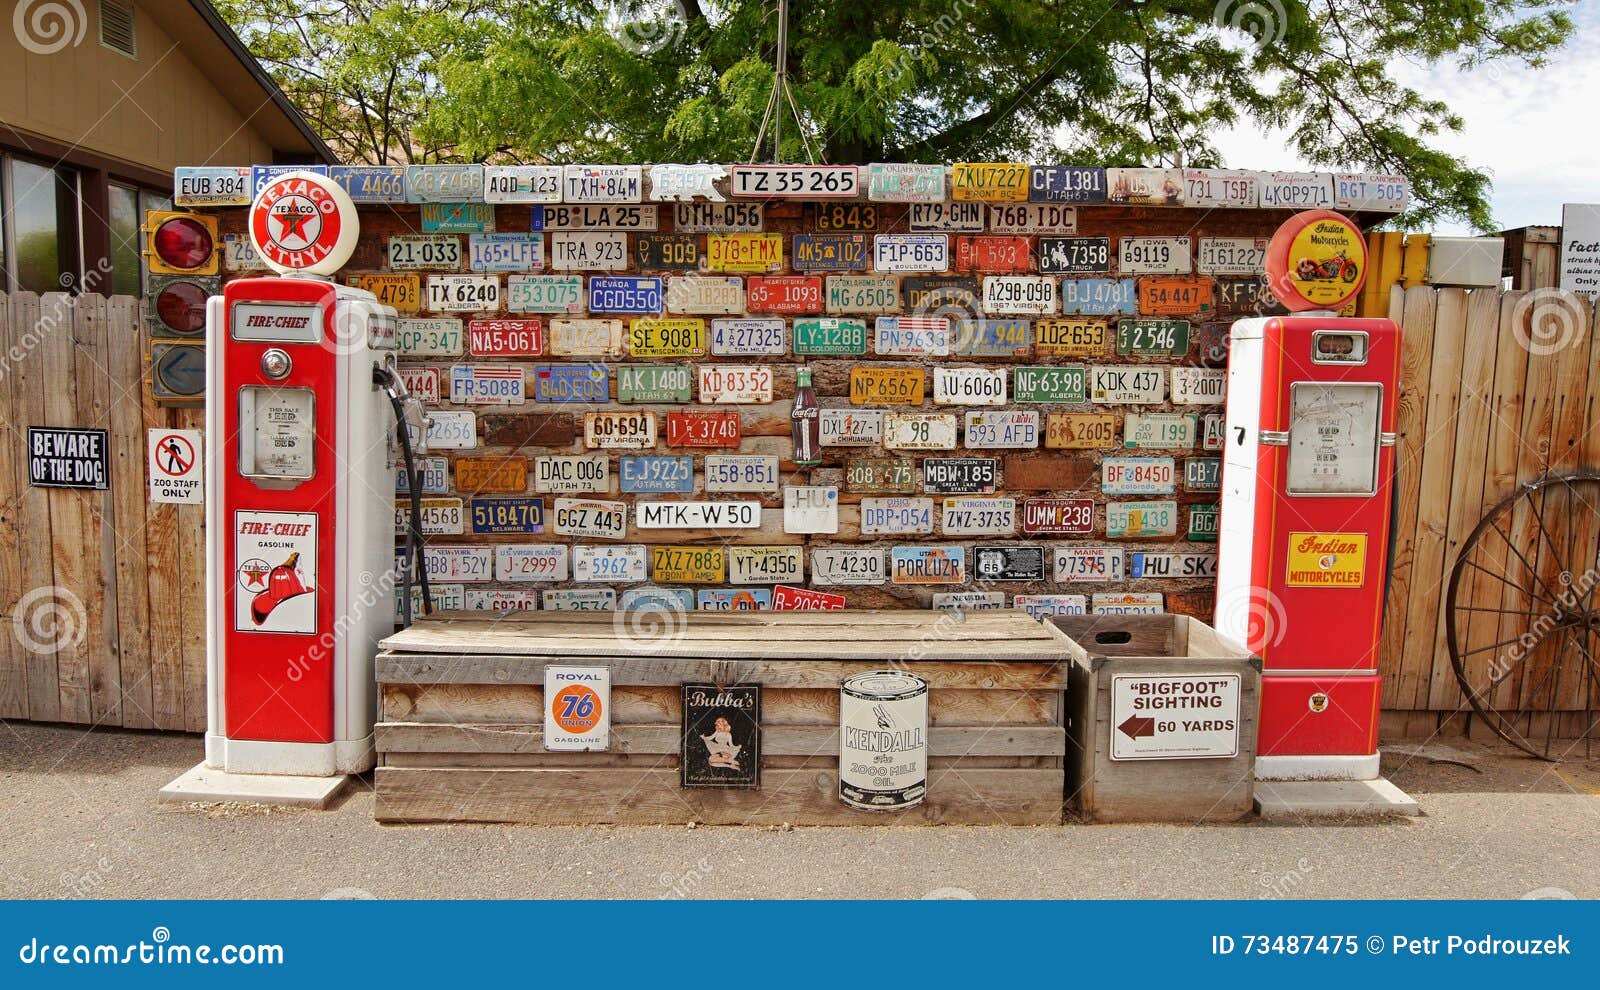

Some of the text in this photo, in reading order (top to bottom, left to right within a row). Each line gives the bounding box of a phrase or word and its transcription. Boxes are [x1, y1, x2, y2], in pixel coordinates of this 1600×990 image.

[182, 178, 210, 194] EUB
[216, 178, 244, 194] 384
[362, 176, 400, 194] 4466
[490, 177, 557, 192] AQD 123
[736, 172, 768, 191] TZ
[776, 173, 803, 191] 35
[810, 172, 854, 191] 265
[958, 169, 1025, 187] ZKU 7227
[1034, 170, 1099, 191] CF 1381
[570, 178, 637, 198] TXH 84M
[1189, 180, 1247, 200] 731 TSB
[1340, 182, 1403, 200] RGT 505
[257, 180, 334, 215] TEXACO
[544, 208, 640, 226] PB LA 25
[833, 207, 875, 228] 843
[914, 204, 979, 222] R79 GHN
[1315, 223, 1344, 234] Indian
[750, 240, 777, 260] FMX
[1310, 235, 1349, 248] Motorcycles
[263, 242, 331, 267] ETHYL
[475, 244, 539, 263] 165 LFE
[557, 242, 622, 260] TRA 923
[663, 244, 696, 264] 909
[1071, 246, 1106, 264] 7358
[1134, 247, 1169, 262] 9119
[380, 285, 406, 304] 479
[431, 285, 496, 302] TX 6240
[784, 287, 818, 302] 1093
[247, 316, 310, 328] FIRE-CHIEF
[634, 329, 653, 348] SE
[660, 329, 699, 348] 9081
[737, 329, 781, 346] 27325
[622, 372, 645, 390] AK
[856, 378, 918, 396] NP 6567
[1097, 372, 1158, 391] KDK 437
[969, 425, 1035, 442] 593 AFB
[1078, 423, 1112, 440] 2605
[33, 433, 99, 458] BEWARE
[33, 458, 103, 482] OF THE DOG
[541, 461, 603, 481] DAC 006
[624, 461, 688, 481] EJ 9225
[963, 466, 993, 482] 185
[154, 479, 199, 488] ZOO STAFF
[162, 488, 191, 498] ONLY
[476, 506, 540, 525] 518470
[558, 509, 622, 531] GGZ 443
[728, 505, 752, 524] 50
[1062, 507, 1091, 525] 238
[240, 522, 311, 536] FIRE-CHIEF
[1298, 536, 1358, 554] Indian
[593, 558, 627, 574] 5962
[656, 552, 721, 570] ZXZ 7883
[984, 564, 998, 572] 66
[1144, 558, 1169, 574] HU
[1290, 570, 1360, 583] MOTORCYCLES
[561, 694, 594, 718] 76
[690, 691, 753, 707] Bubba's
[1134, 696, 1222, 709] SIGHTING
[1158, 720, 1234, 732] 60 YARDS
[845, 726, 923, 752] KENDALL
[850, 762, 916, 776] 2000 MILE
[873, 777, 894, 786] OIL
